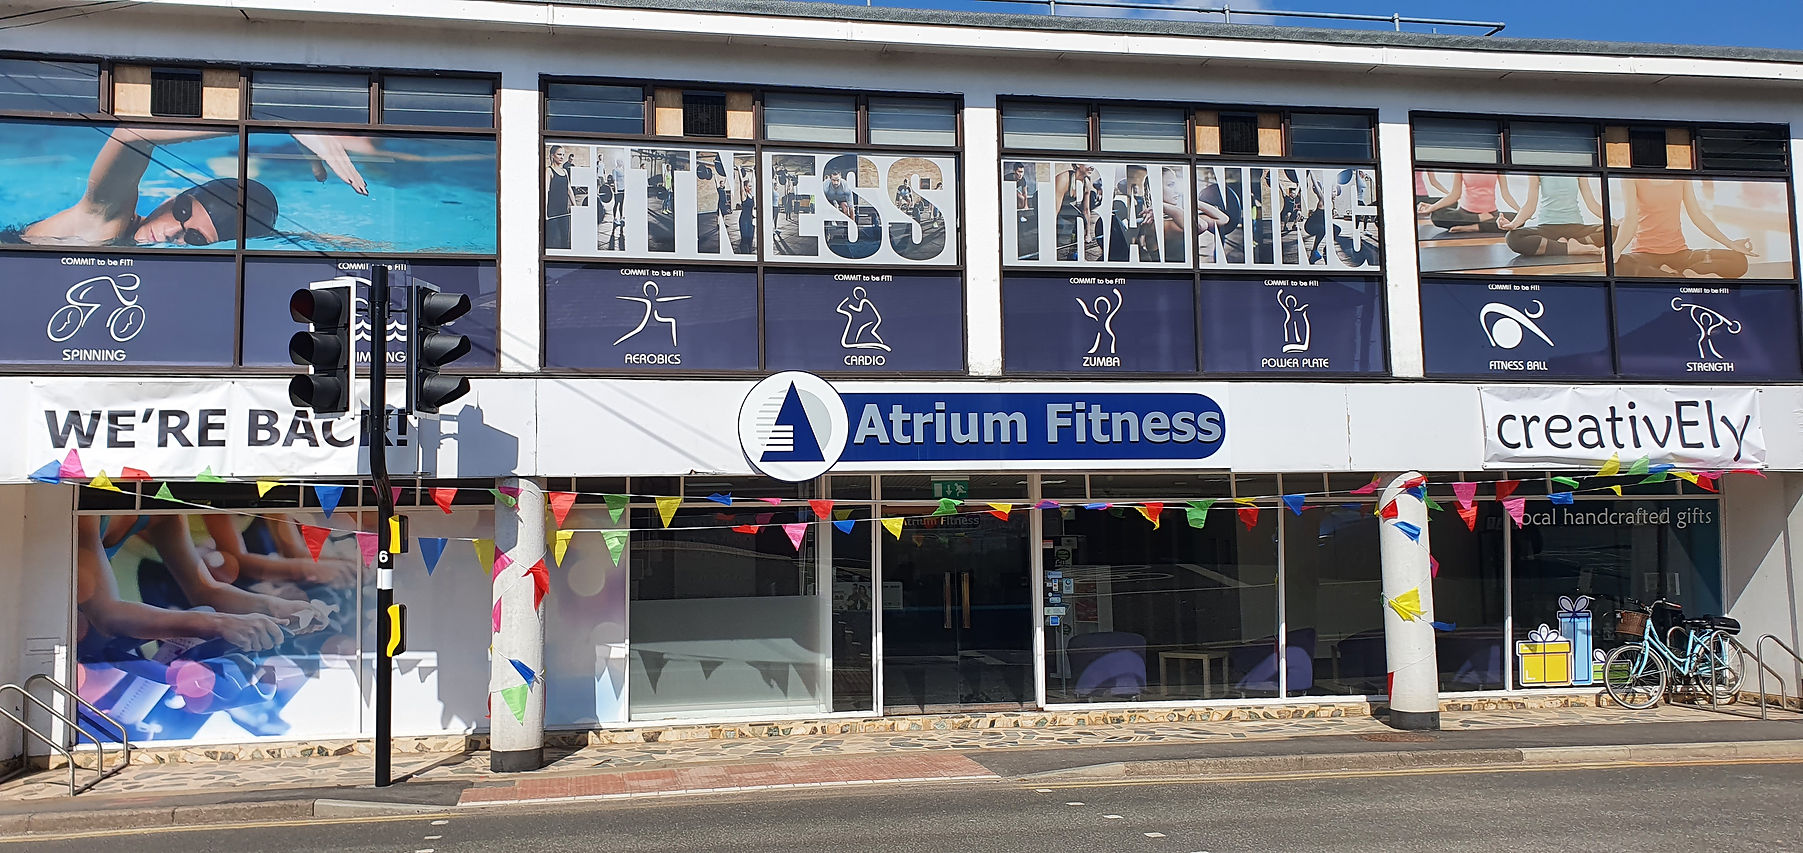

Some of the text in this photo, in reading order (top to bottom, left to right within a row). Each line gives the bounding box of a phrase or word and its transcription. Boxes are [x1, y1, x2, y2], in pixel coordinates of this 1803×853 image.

[546, 144, 1380, 268] FITNESS TRAINING
[61, 257, 95, 266] COMMIT
[337, 262, 369, 270] COMMIT
[620, 268, 649, 276] COMMIT
[62, 348, 127, 361] SPINNING
[624, 353, 681, 365] AEROBICS
[843, 355, 886, 366] CARDIO
[1082, 356, 1121, 367] ZUMBA
[1261, 357, 1330, 368] POWER PLATE
[1489, 360, 1549, 371] FITNESS BALL
[1686, 362, 1735, 373] STRENGTH
[853, 401, 1222, 445] Atrium Fitness
[1496, 400, 1752, 463] creativEly
[940, 516, 980, 526] Fitness
[1516, 508, 1556, 526] ocal
[1563, 508, 1671, 526] handcrafted
[1676, 508, 1713, 529] gifts
[378, 550, 389, 563] 6
